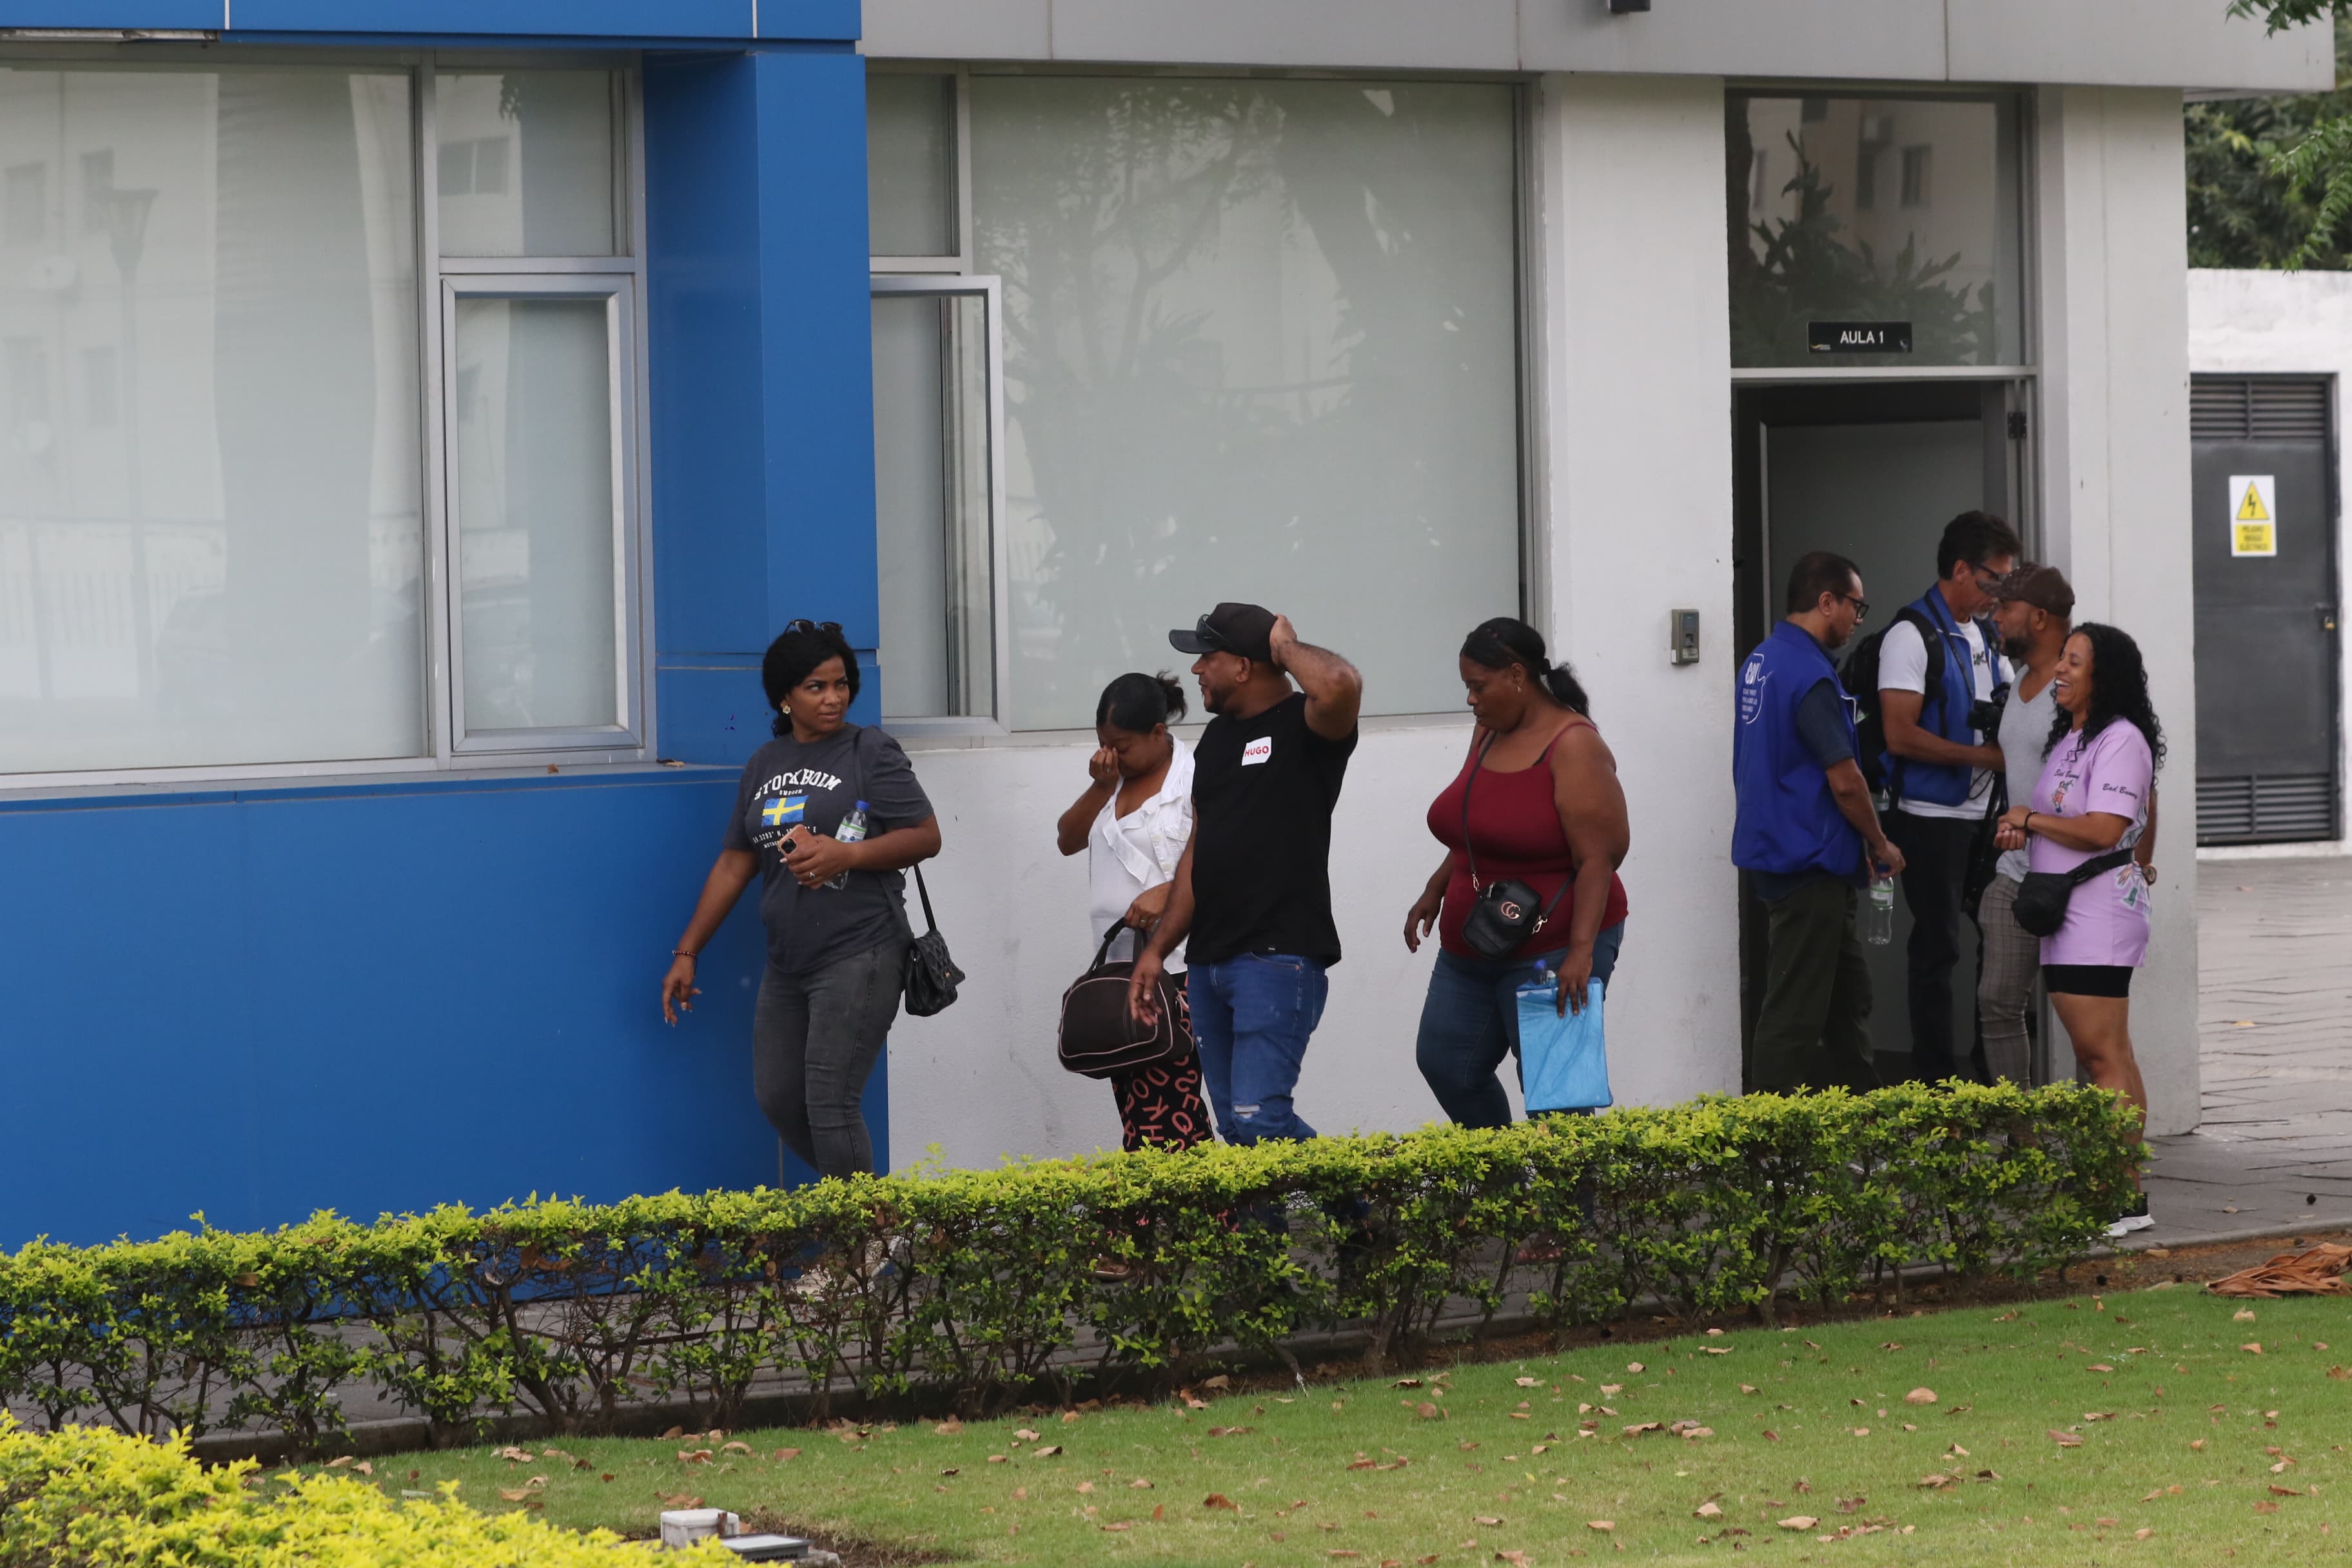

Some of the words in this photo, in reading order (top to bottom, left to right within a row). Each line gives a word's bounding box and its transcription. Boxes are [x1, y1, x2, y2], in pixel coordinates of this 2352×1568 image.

[1840, 331, 1875, 344] AULA
[1879, 331, 1884, 344] 1
[1244, 745, 1269, 757] HUGO
